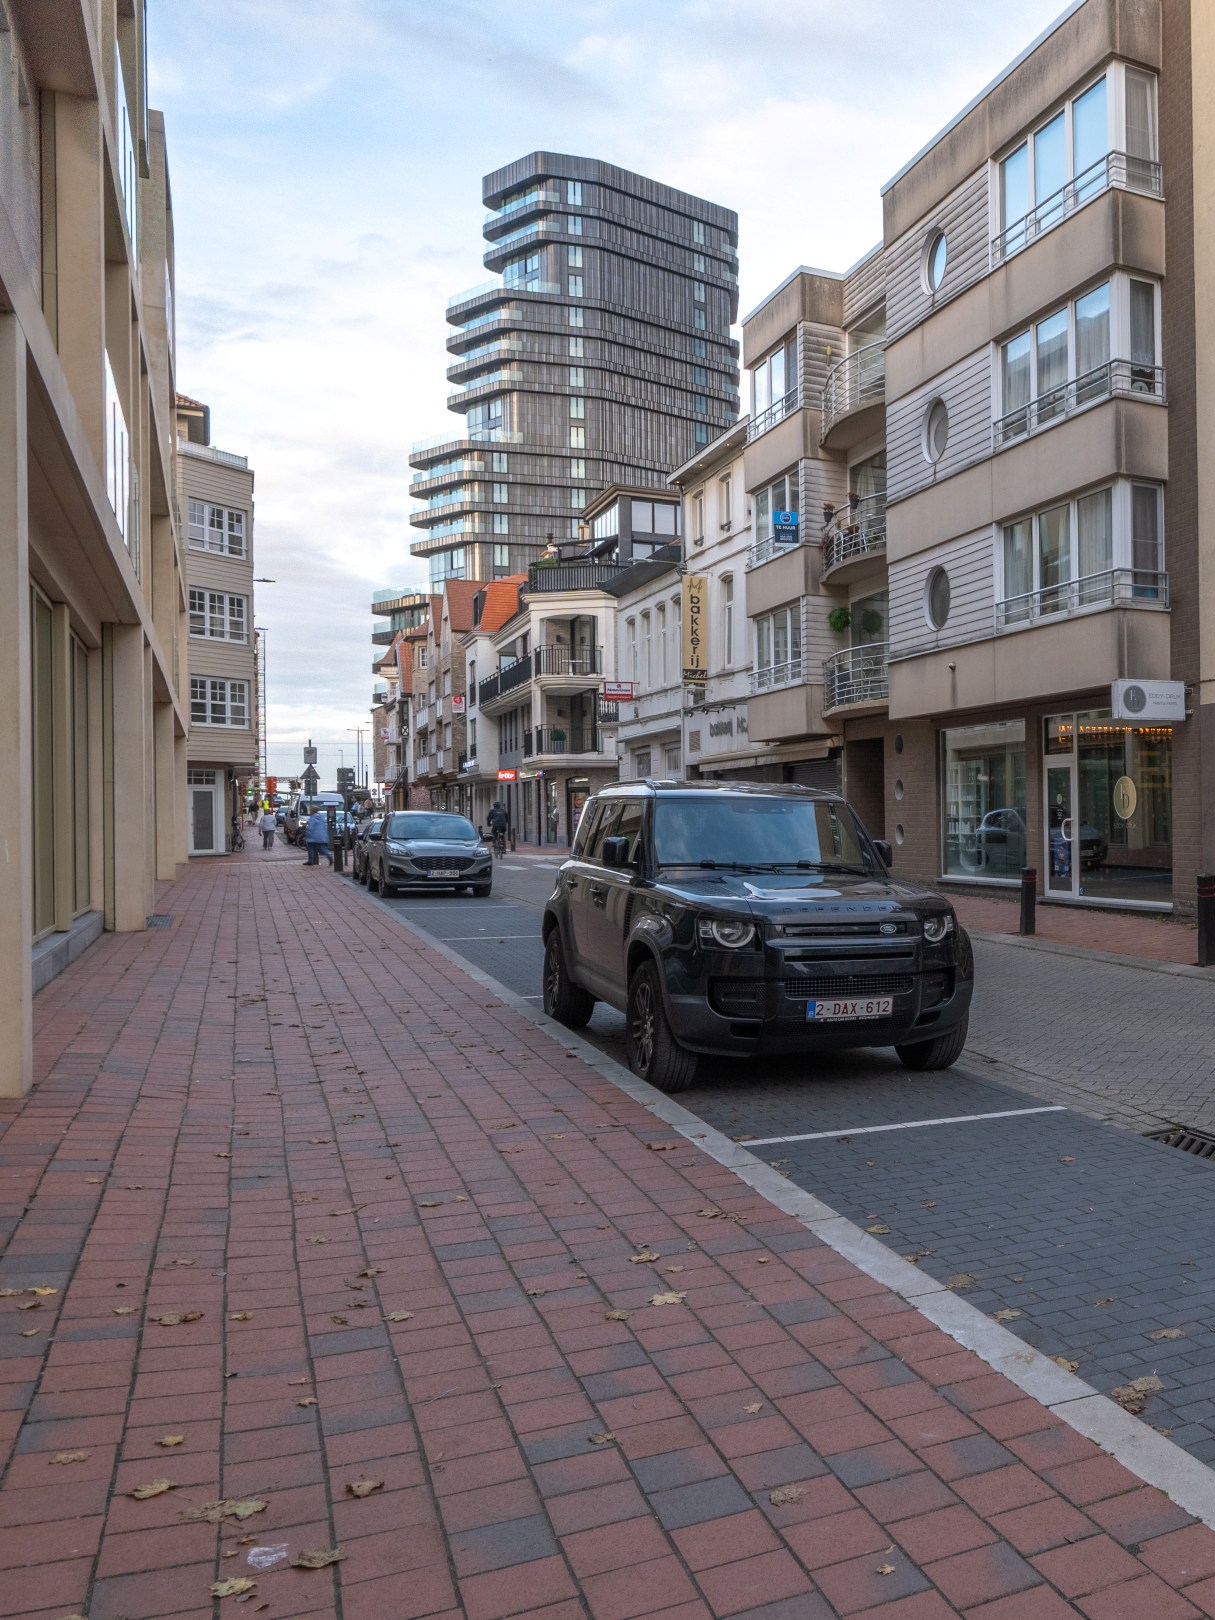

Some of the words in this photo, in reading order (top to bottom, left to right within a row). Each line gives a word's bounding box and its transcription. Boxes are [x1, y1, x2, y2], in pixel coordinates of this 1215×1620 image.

[690, 593, 701, 669] bakkerij
[682, 670, 708, 680] Michel
[782, 905, 903, 913] DEFENDER
[815, 1000, 891, 1016] 2-DAX-612
